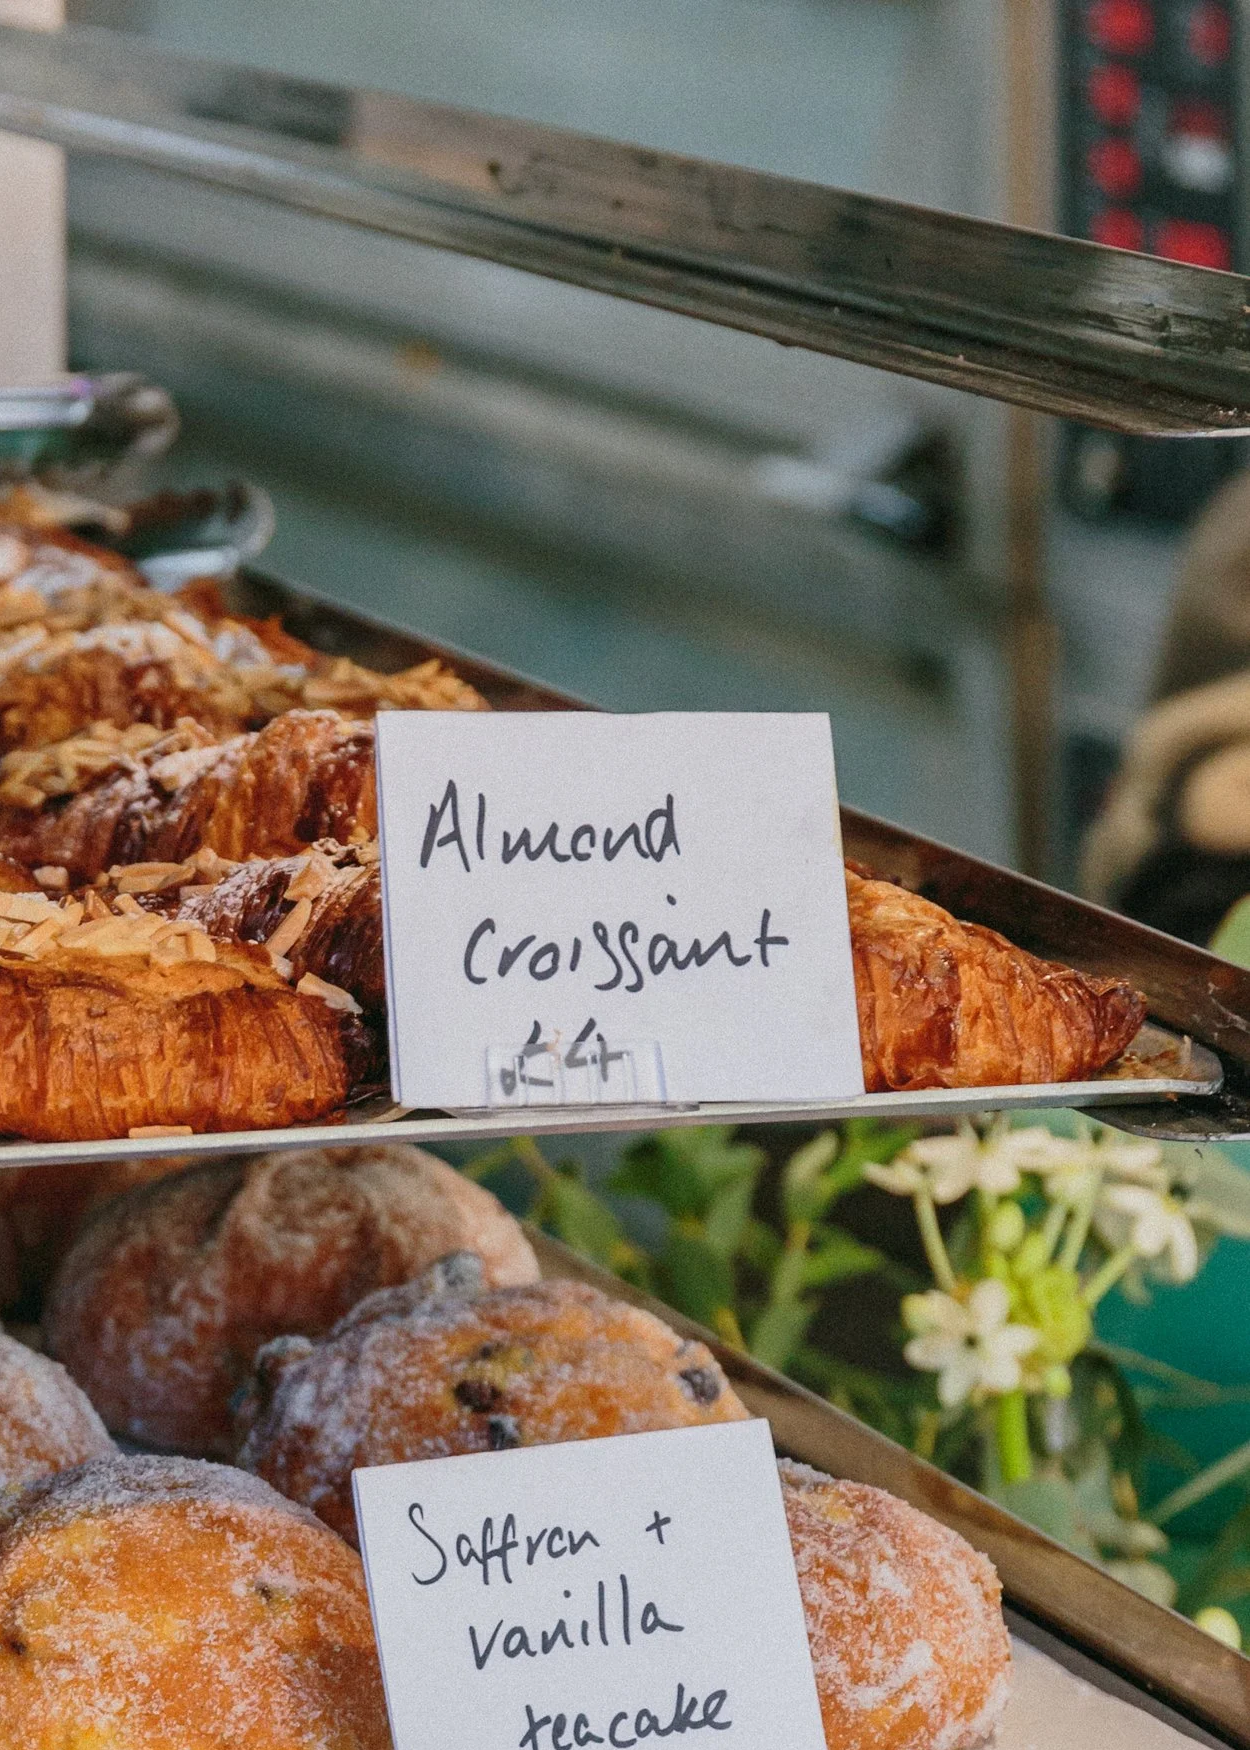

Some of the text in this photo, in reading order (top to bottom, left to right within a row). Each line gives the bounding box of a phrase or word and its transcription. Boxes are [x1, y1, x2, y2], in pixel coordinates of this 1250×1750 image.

[420, 779, 680, 872] Almond
[464, 894, 789, 993] Croissant
[408, 1502, 600, 1586] Saffron
[469, 1574, 684, 1669] vanilla
